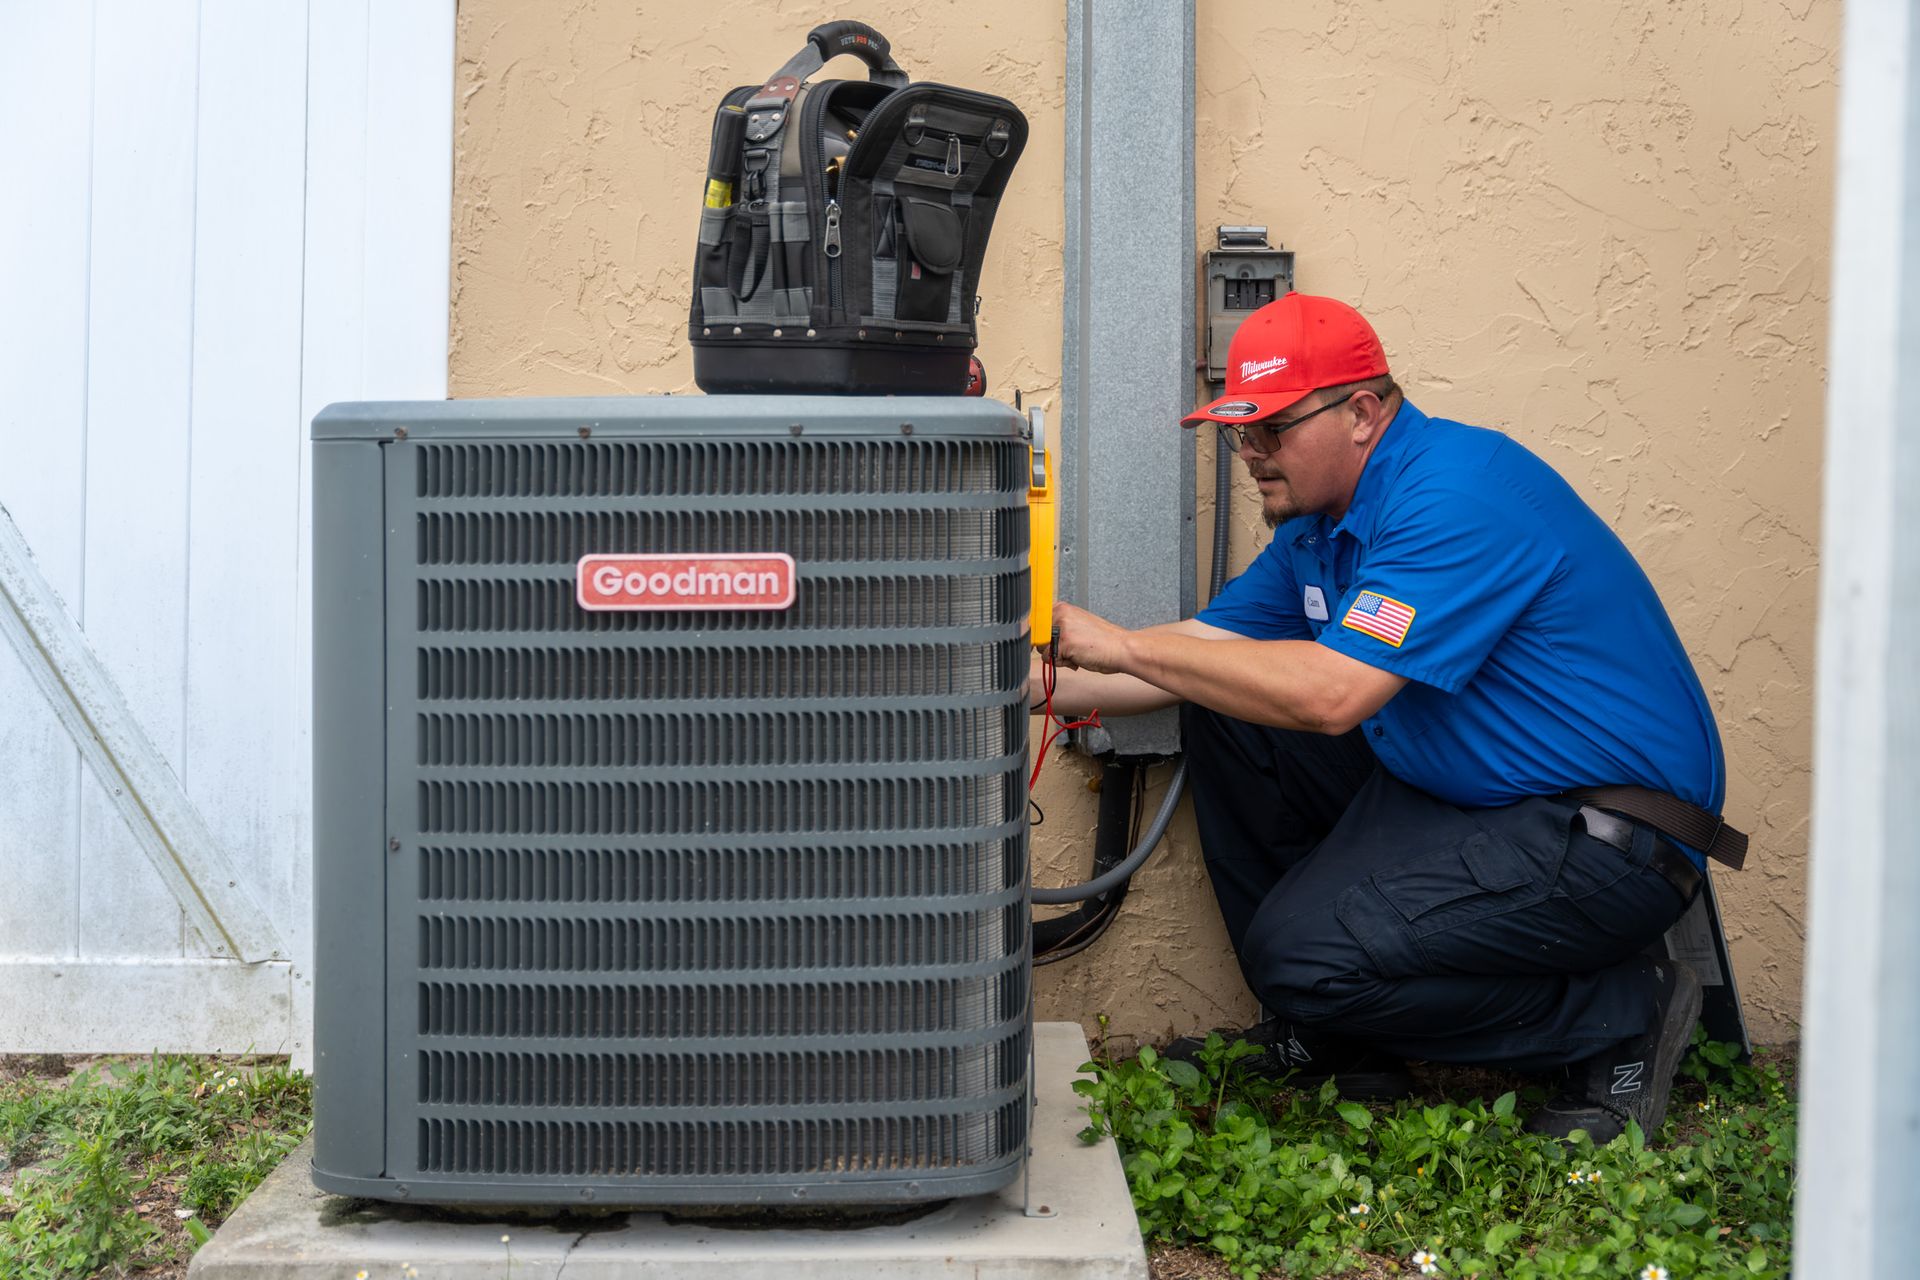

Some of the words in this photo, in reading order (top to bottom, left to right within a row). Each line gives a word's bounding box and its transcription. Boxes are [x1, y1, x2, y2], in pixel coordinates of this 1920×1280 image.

[1239, 356, 1288, 379] Milwaukee
[592, 565, 780, 597] Goodman
[1307, 596, 1320, 608] Cam
[1611, 1061, 1644, 1095] N
